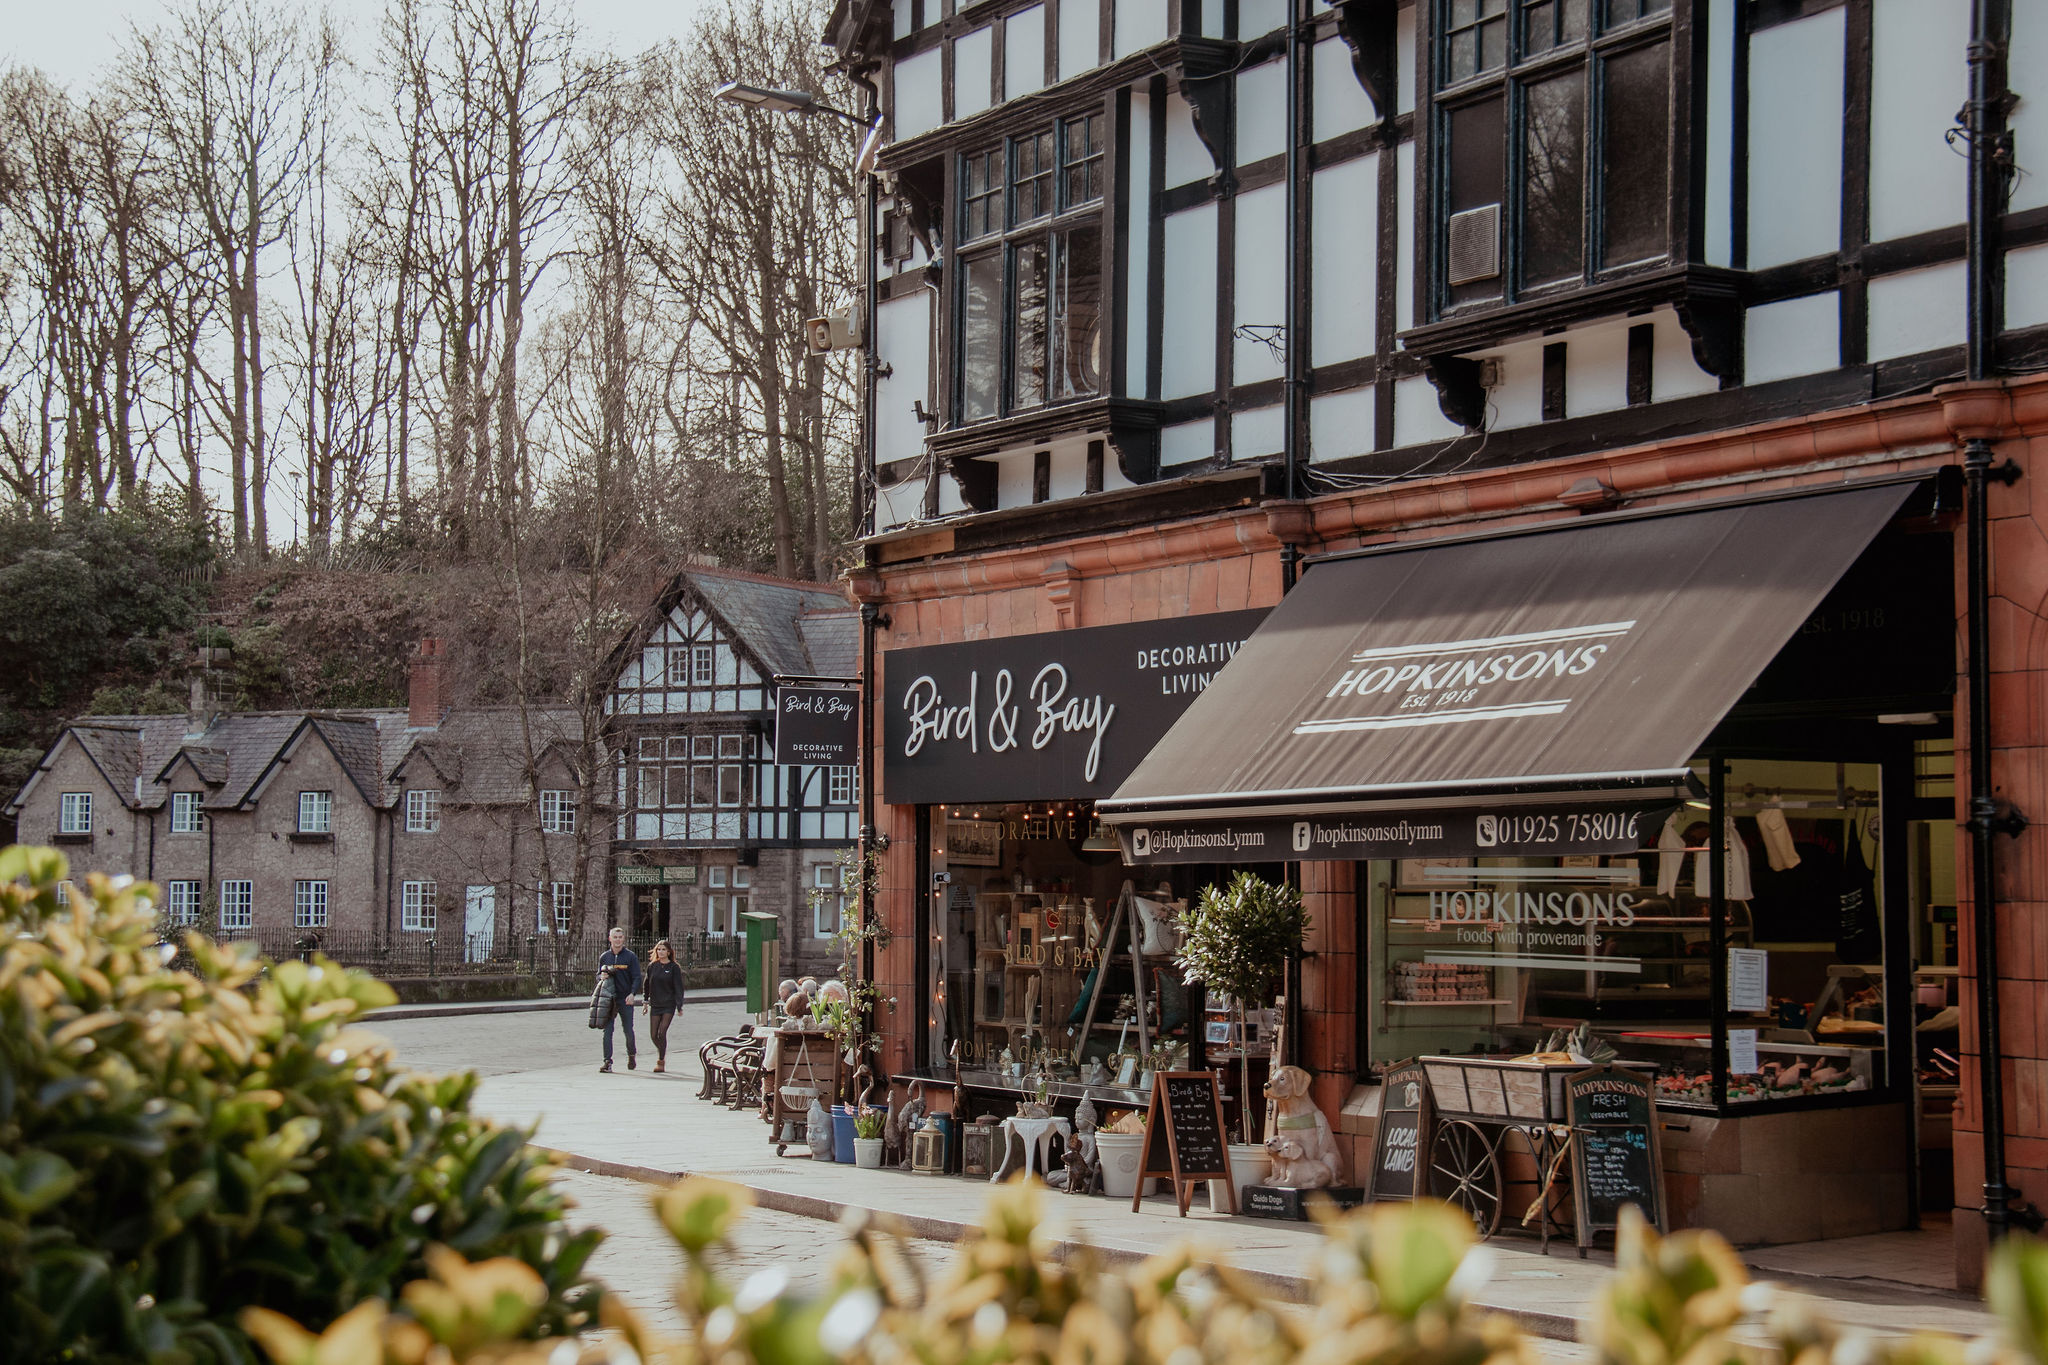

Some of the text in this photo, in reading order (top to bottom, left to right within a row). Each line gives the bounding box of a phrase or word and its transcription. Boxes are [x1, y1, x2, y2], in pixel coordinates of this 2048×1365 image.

[1840, 608, 1885, 632] 1918
[1137, 640, 1248, 670] DECORATIV
[1162, 671, 1221, 695] LIVIN
[1326, 644, 1608, 698] HOPKINSONS
[785, 695, 853, 721] Bird & Bay
[1436, 688, 1478, 706] 1918
[903, 662, 1115, 783] Bird & Bay
[792, 744, 843, 752] DECORATIVE
[803, 752, 832, 760] LIVING
[957, 819, 1076, 841] DECORATIVE
[1150, 828, 1265, 853] @HopkinsonsLymm
[1312, 820, 1443, 847] /hopkinsonsoflymm
[1499, 815, 1560, 844] 01925
[617, 875, 660, 884] SOLICITORS
[1429, 890, 1635, 928] HOPKINSONS
[1456, 926, 1602, 948] Foods with provenance
[1005, 943, 1106, 969] BIRD & BAY
[1572, 1080, 1648, 1098] HOPKINSONS
[1592, 1093, 1627, 1107] FRESH
[1386, 1127, 1418, 1147] LOCAL
[1383, 1148, 1415, 1172] LAMB
[1268, 1194, 1283, 1205] Dogs
